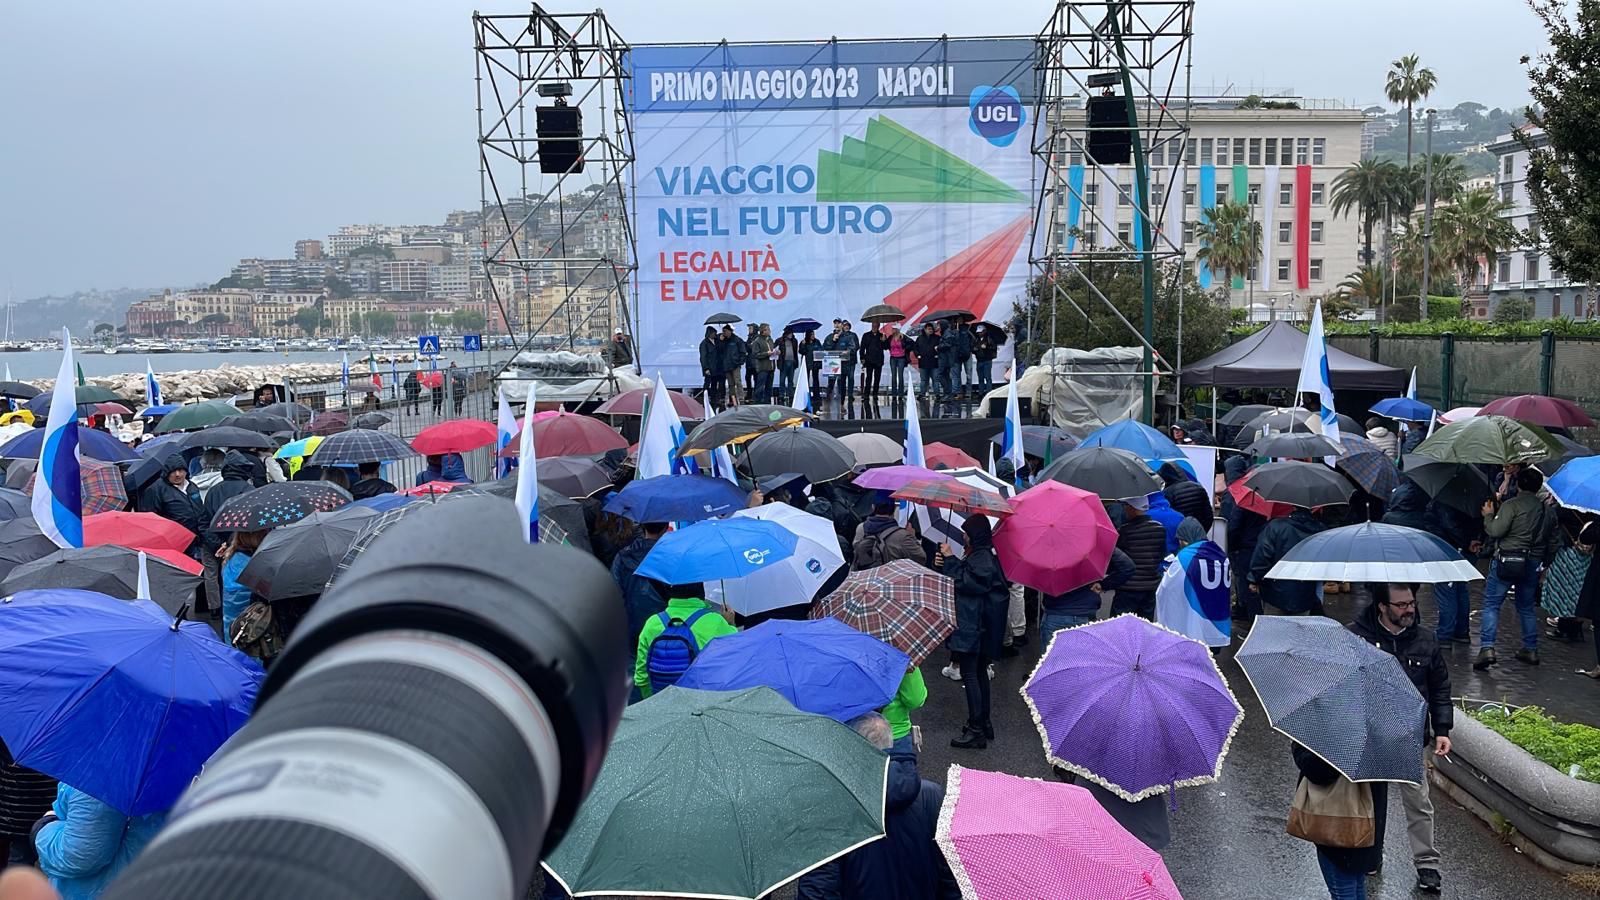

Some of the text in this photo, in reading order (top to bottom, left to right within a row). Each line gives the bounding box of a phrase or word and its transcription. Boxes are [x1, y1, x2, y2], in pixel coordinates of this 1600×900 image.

[651, 66, 954, 101] PRIMO MAGGIO 2023 NAPOLI
[978, 105, 1018, 122] UGL
[655, 164, 815, 195] VIAGGIO
[658, 204, 893, 236] NEL FUTURO
[659, 244, 780, 273] LEGALITÀ
[661, 278, 789, 301] E LAVORO
